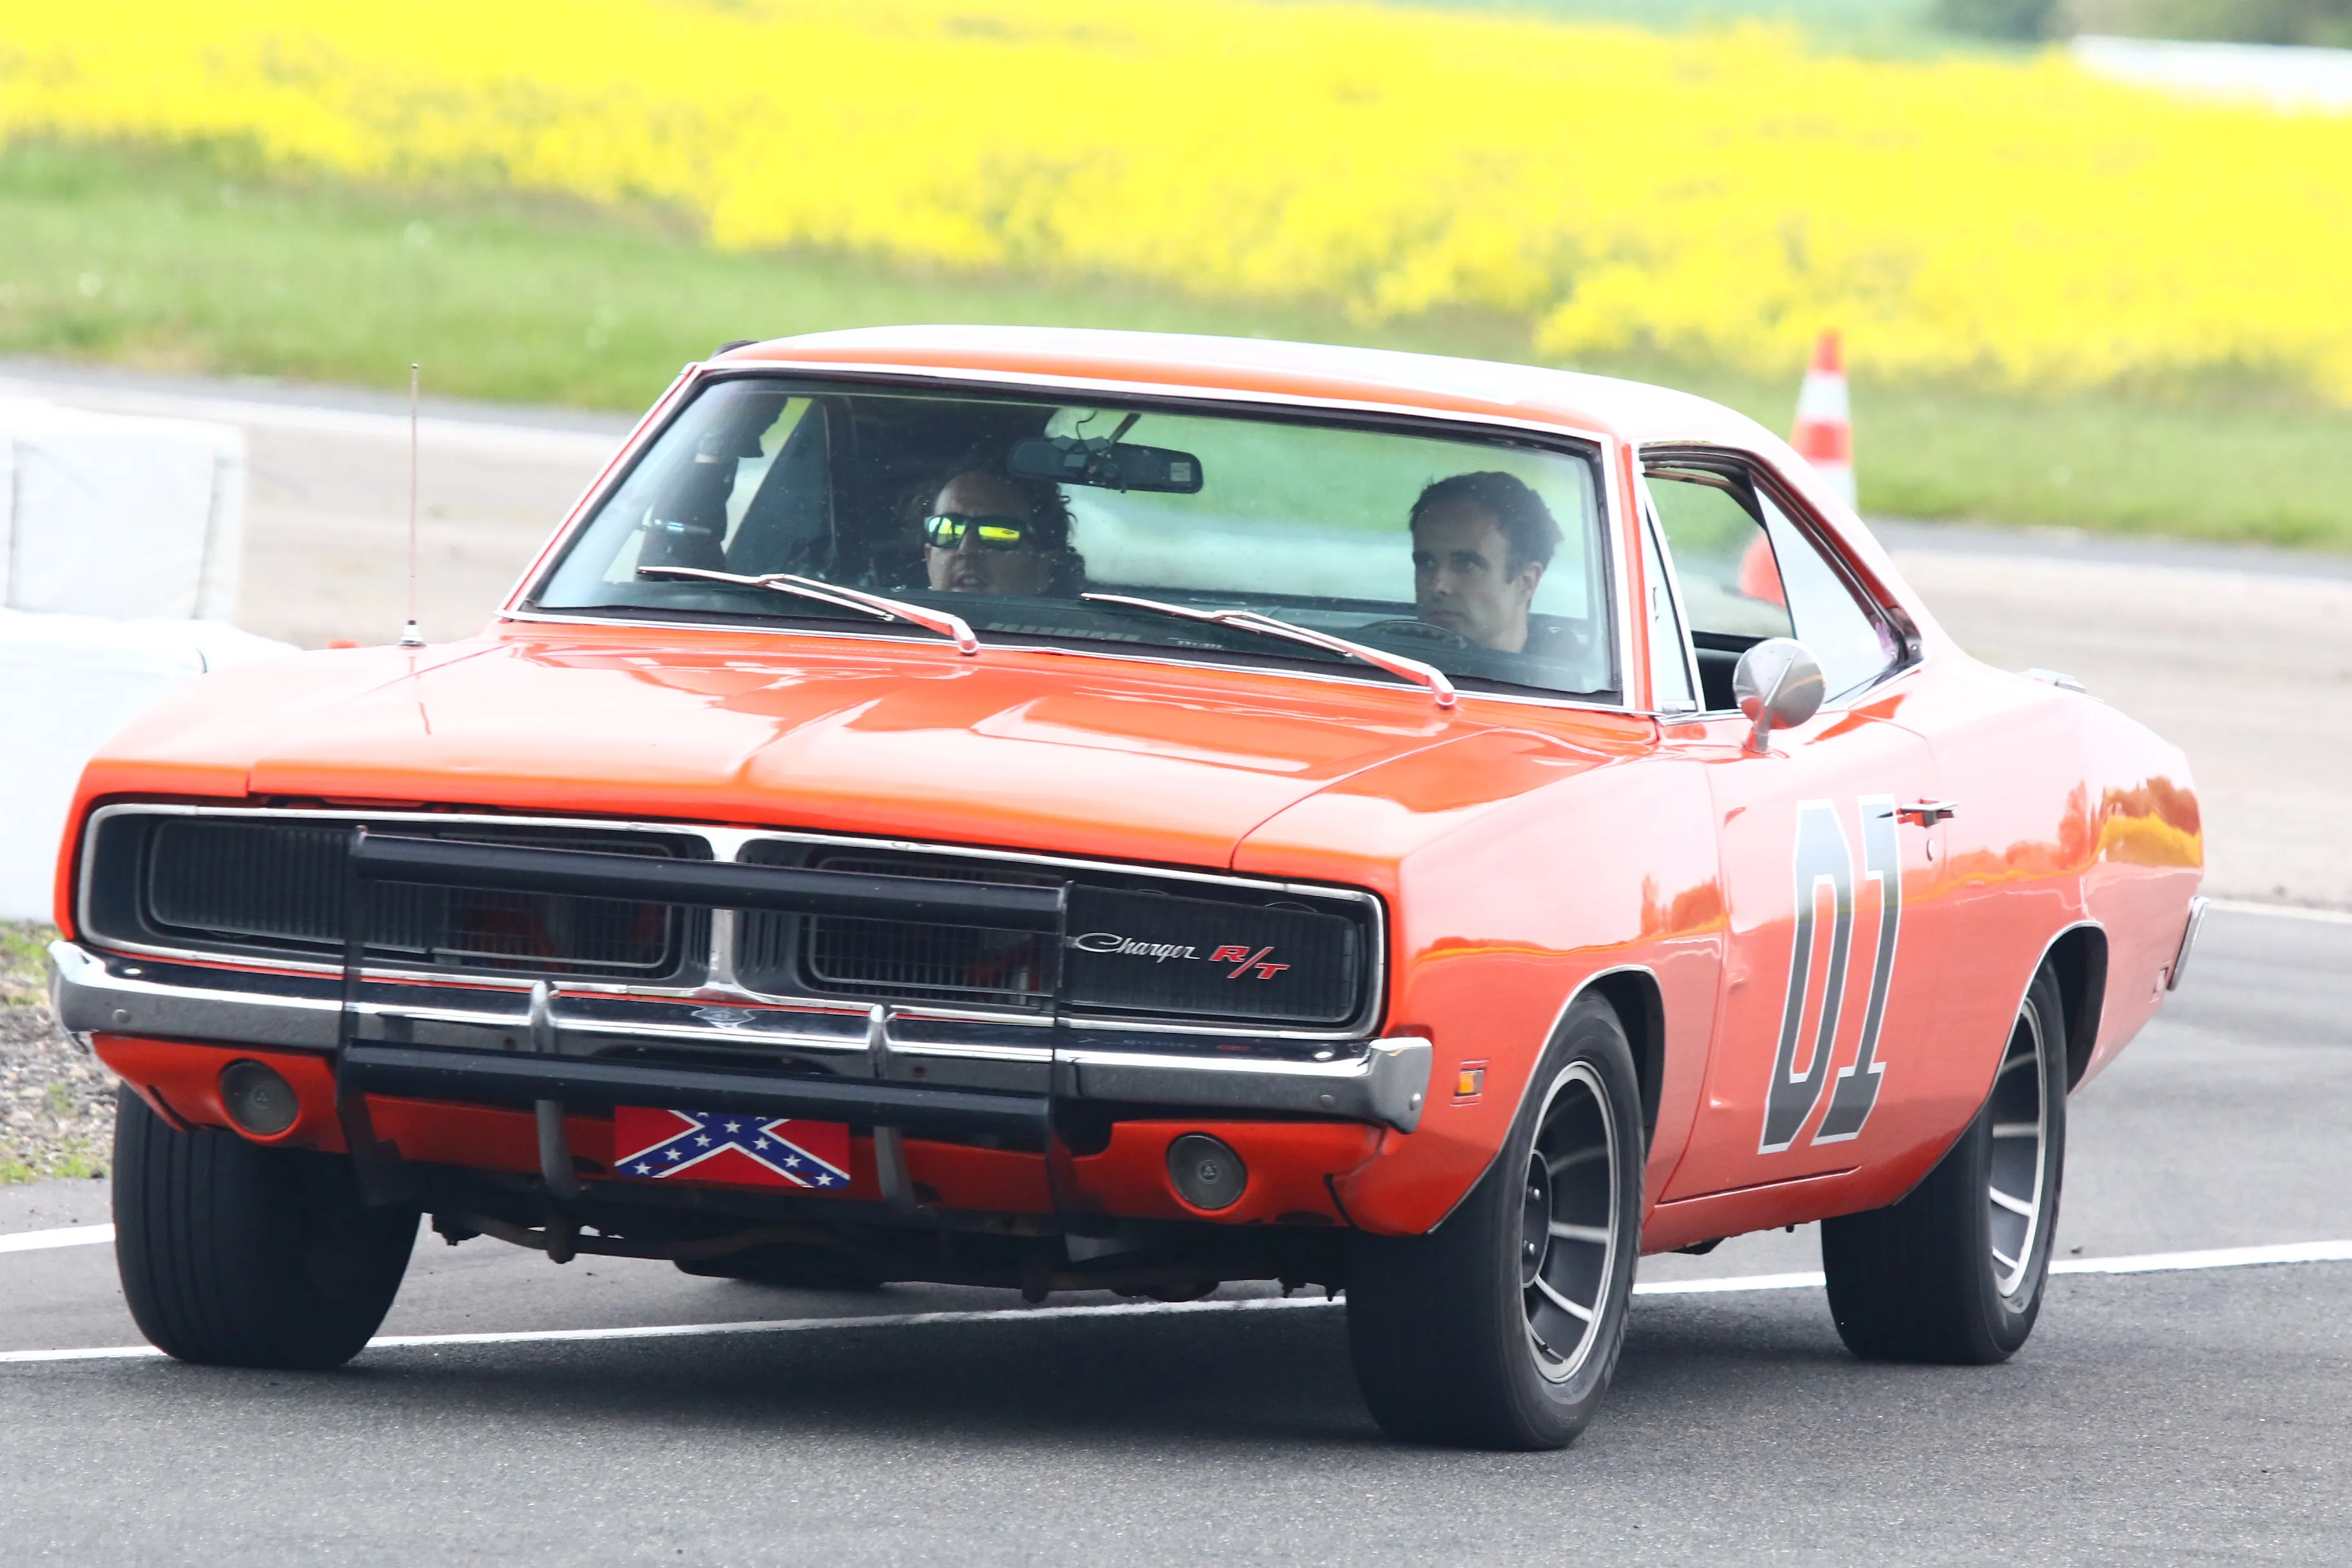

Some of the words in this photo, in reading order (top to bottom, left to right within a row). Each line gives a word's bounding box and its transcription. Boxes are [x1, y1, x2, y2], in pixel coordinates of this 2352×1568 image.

[1074, 932, 1200, 963] Charger
[1208, 945, 1291, 979] R/T
[1758, 794, 1901, 1155] 01
